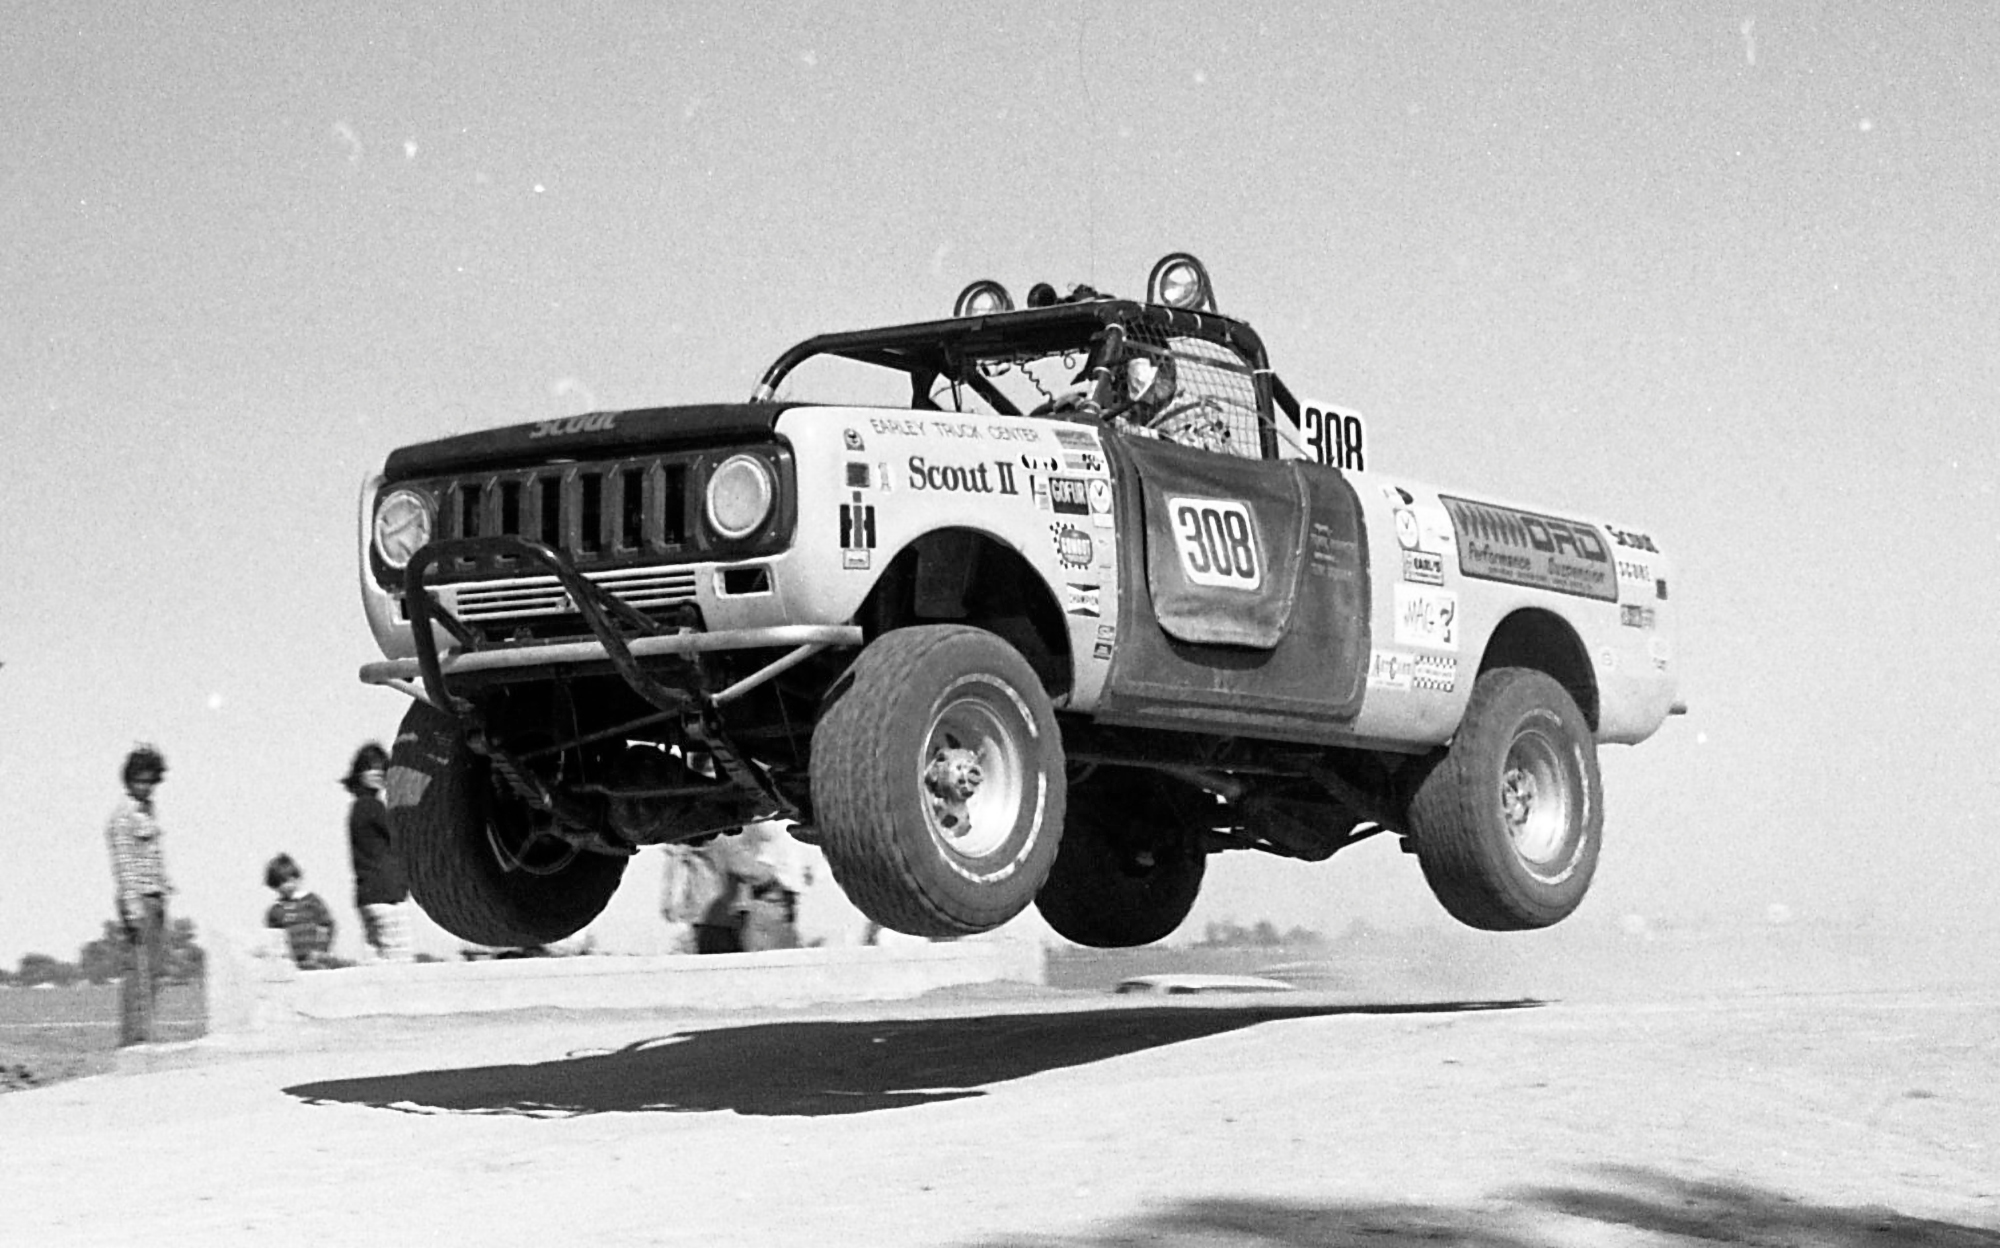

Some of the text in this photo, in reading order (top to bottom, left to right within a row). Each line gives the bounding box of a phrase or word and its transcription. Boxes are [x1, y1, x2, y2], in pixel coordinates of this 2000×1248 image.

[869, 418, 925, 436] EARLEY
[931, 422, 982, 440] TRUCK
[988, 425, 1040, 442] CENTER
[1305, 406, 1365, 473] 308
[908, 455, 993, 494] Scout
[994, 460, 1019, 495] II
[1177, 506, 1256, 579] 308
[1468, 541, 1532, 571] Performance
